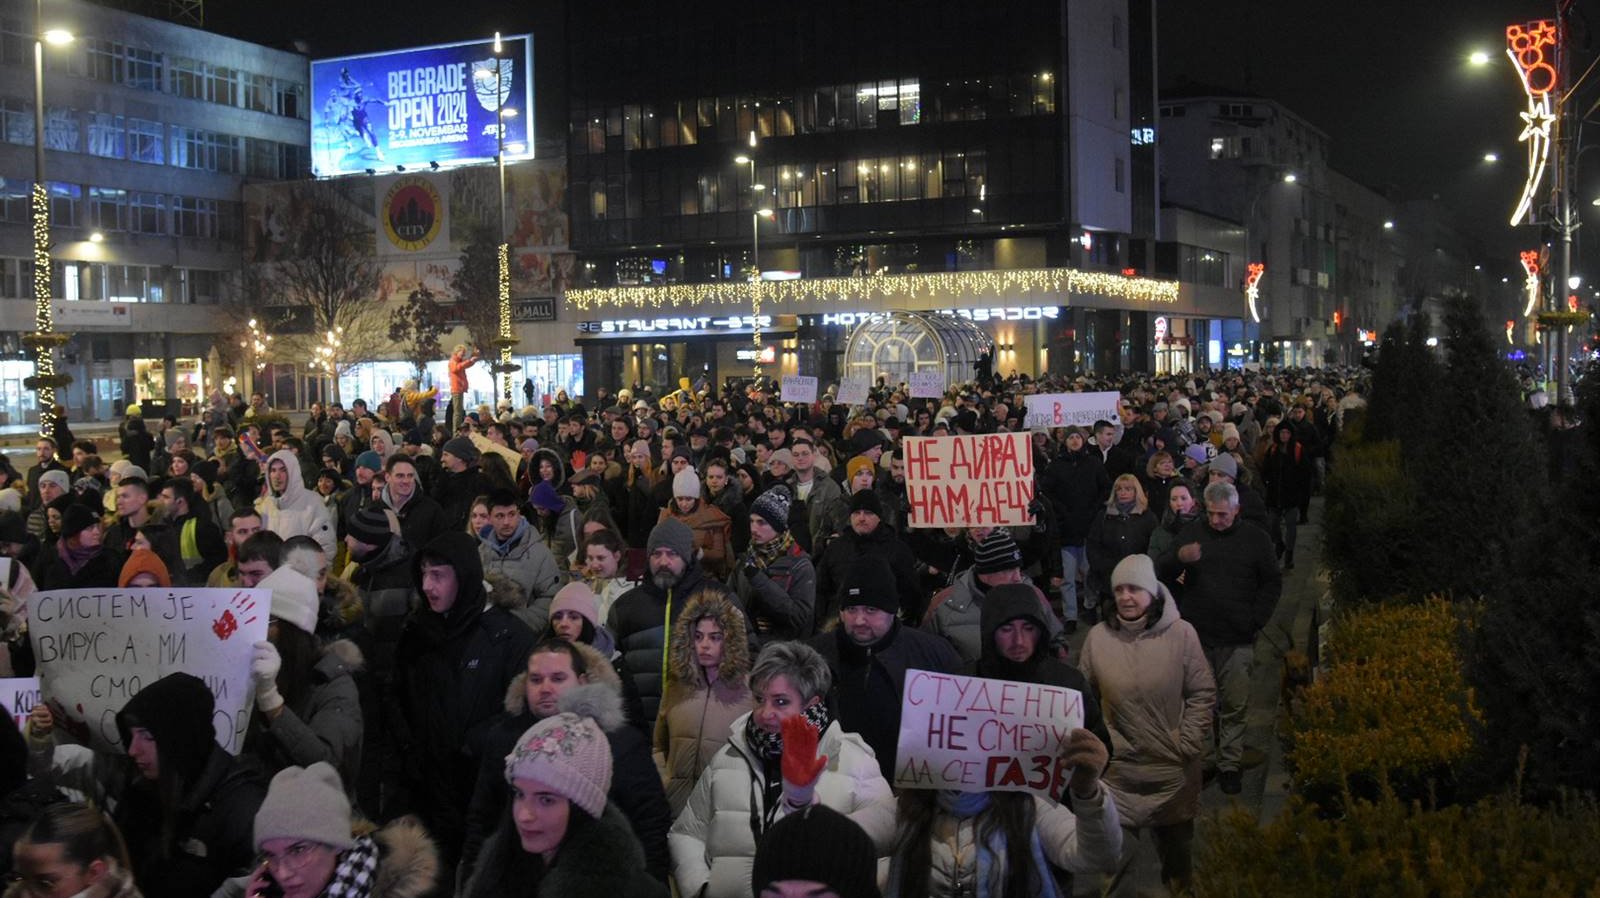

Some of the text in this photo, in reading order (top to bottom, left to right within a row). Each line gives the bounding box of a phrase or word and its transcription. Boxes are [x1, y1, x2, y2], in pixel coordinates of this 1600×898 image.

[388, 62, 467, 99] BELGRADE
[388, 92, 468, 131] OPEN 2024
[409, 124, 468, 139] NOVEMBAR
[397, 224, 426, 236] CITY
[906, 434, 1032, 480] НЕ ДИРАЈ
[909, 484, 971, 524] НАМ
[37, 595, 149, 622] СИСТЕМ
[122, 635, 138, 664] А
[158, 633, 187, 665] МИ
[91, 674, 141, 698] СМО
[908, 672, 1081, 719] СТУДЕНТИ
[928, 713, 1067, 752] НЕ СМЕЈУ
[897, 757, 934, 785] ДА
[941, 759, 981, 784] СЕ
